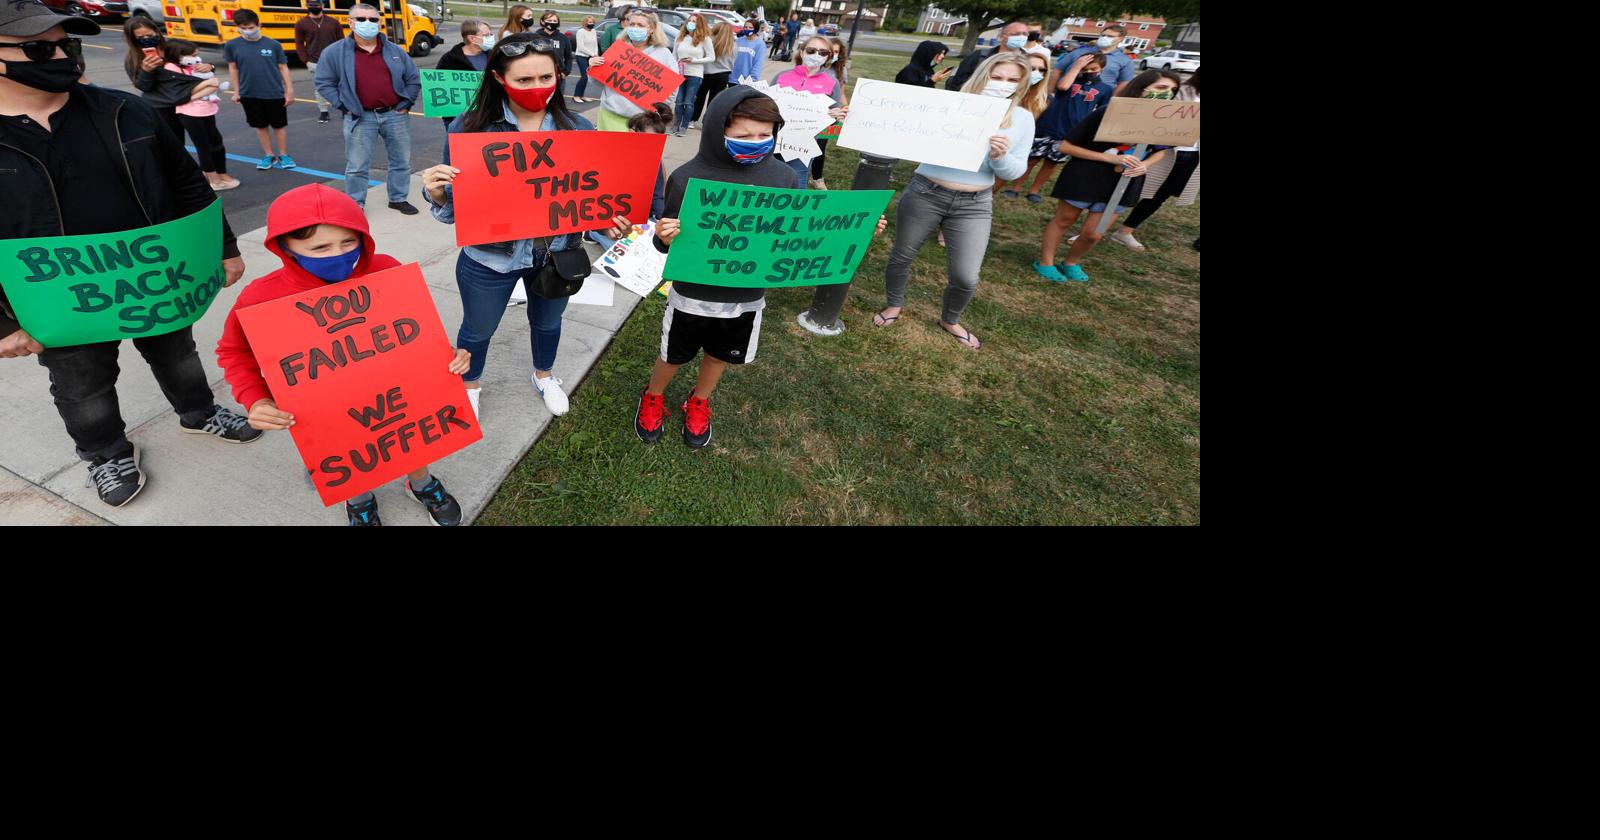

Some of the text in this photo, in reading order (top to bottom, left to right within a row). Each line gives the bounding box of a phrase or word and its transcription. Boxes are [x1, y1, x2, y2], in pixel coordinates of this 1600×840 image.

[423, 72, 445, 81] WE
[610, 60, 664, 93] IN PERSON
[620, 48, 664, 80] SCHOOL
[605, 71, 649, 99] NOW
[482, 138, 556, 177] FIX
[525, 170, 600, 200] THIS
[699, 188, 828, 211] WITHOUT
[549, 193, 632, 231] MESS
[808, 211, 870, 232] WONT
[16, 234, 170, 282] BRING
[707, 233, 825, 254] NO HOW
[706, 258, 757, 275] TOO
[67, 261, 195, 313] BACK
[295, 285, 371, 327] YOU
[279, 317, 420, 387] FAILED
[347, 386, 408, 428] WE
[319, 404, 471, 488] SUFFER
